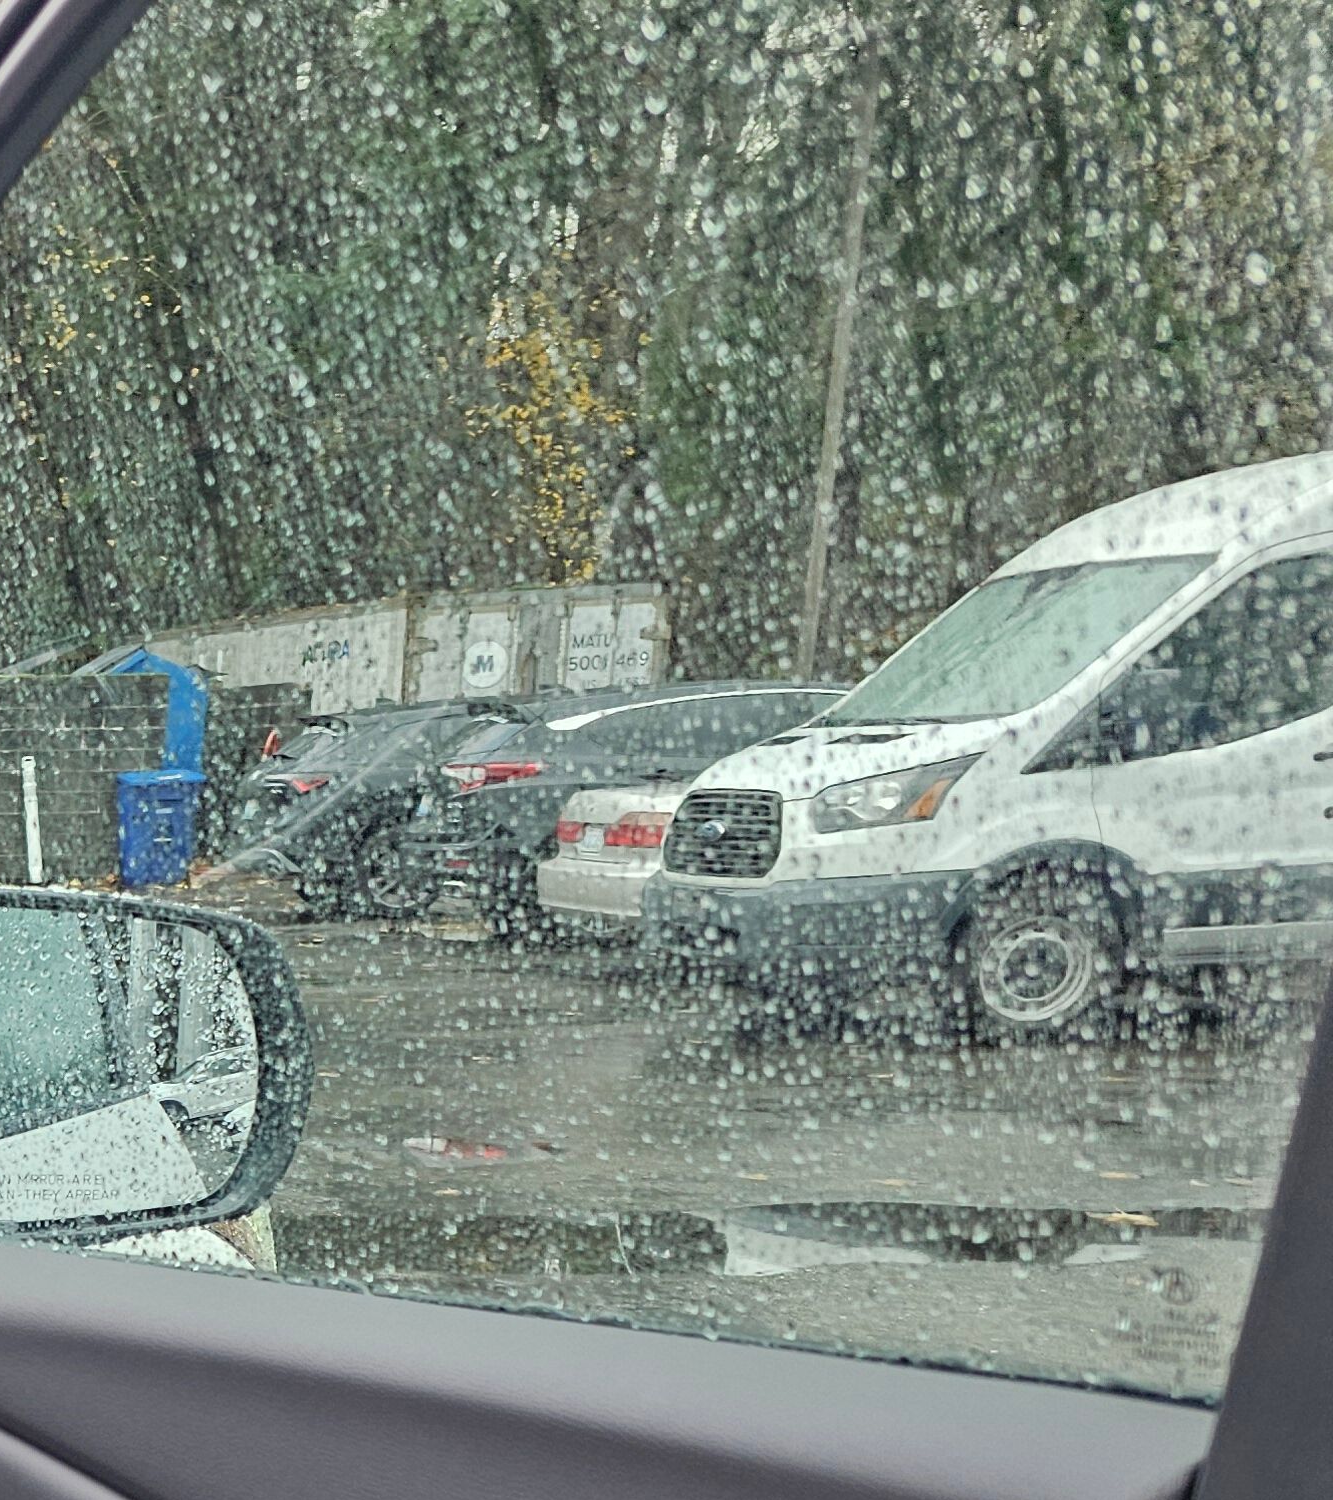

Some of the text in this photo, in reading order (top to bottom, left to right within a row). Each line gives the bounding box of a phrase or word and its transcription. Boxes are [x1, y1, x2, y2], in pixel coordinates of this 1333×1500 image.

[571, 632, 613, 649] MATU
[71, 1173, 104, 1186] ARE
[65, 1188, 121, 1202] APPEAR
